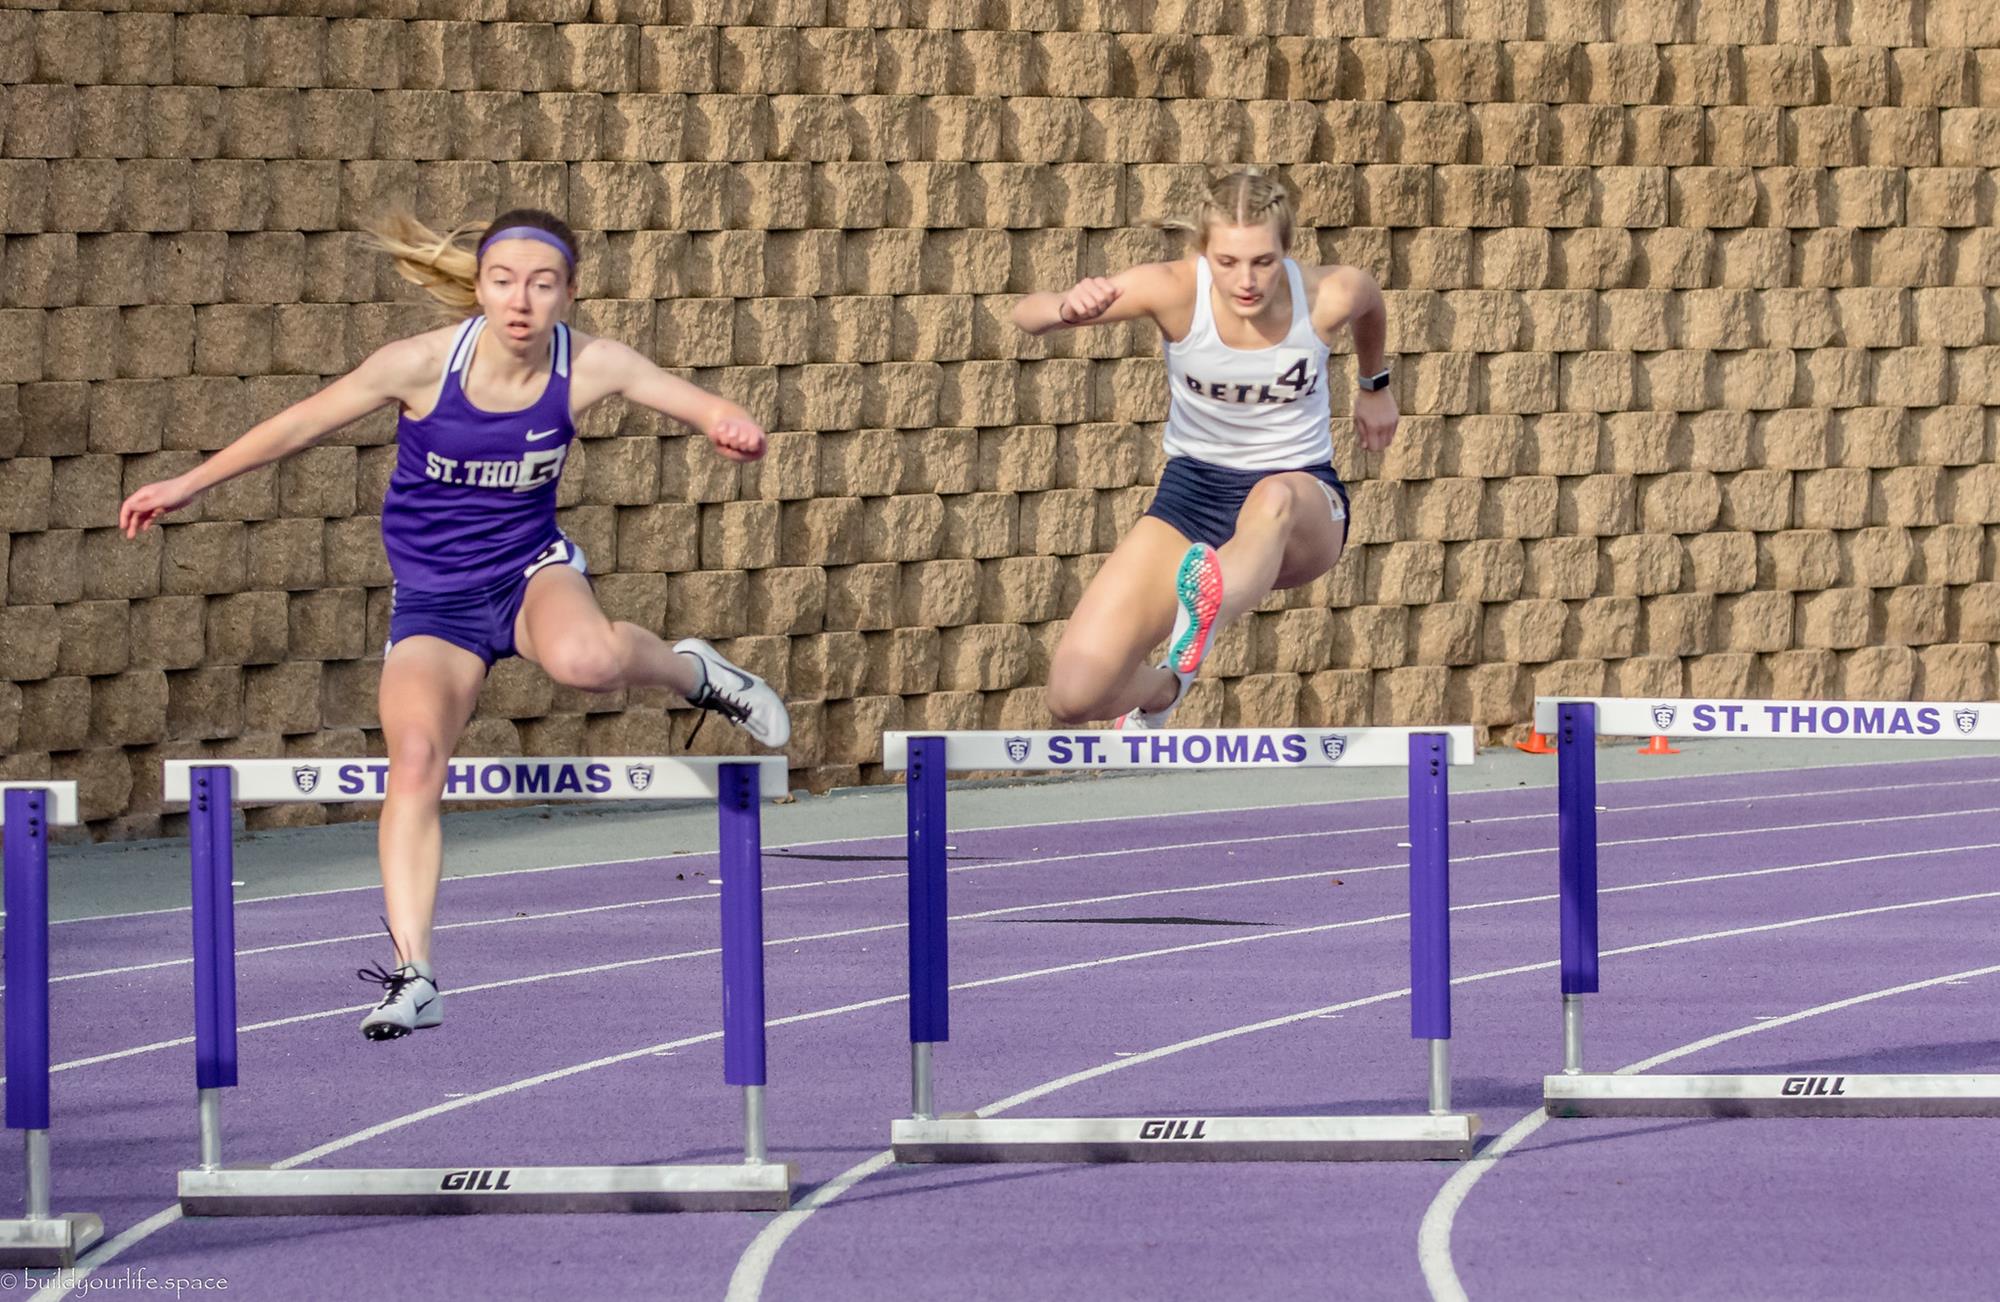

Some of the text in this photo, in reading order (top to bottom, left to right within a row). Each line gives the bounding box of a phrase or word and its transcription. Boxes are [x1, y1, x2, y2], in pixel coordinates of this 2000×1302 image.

[1276, 357, 1309, 392] 4
[1692, 703, 1941, 735] ST. THOMAS
[1047, 734, 1308, 764] ST. THOMAS
[338, 763, 612, 794] ST HOMAS
[1781, 1077, 1845, 1096] GILL
[1139, 1119, 1206, 1139] GILL
[440, 1169, 511, 1190] GILL
